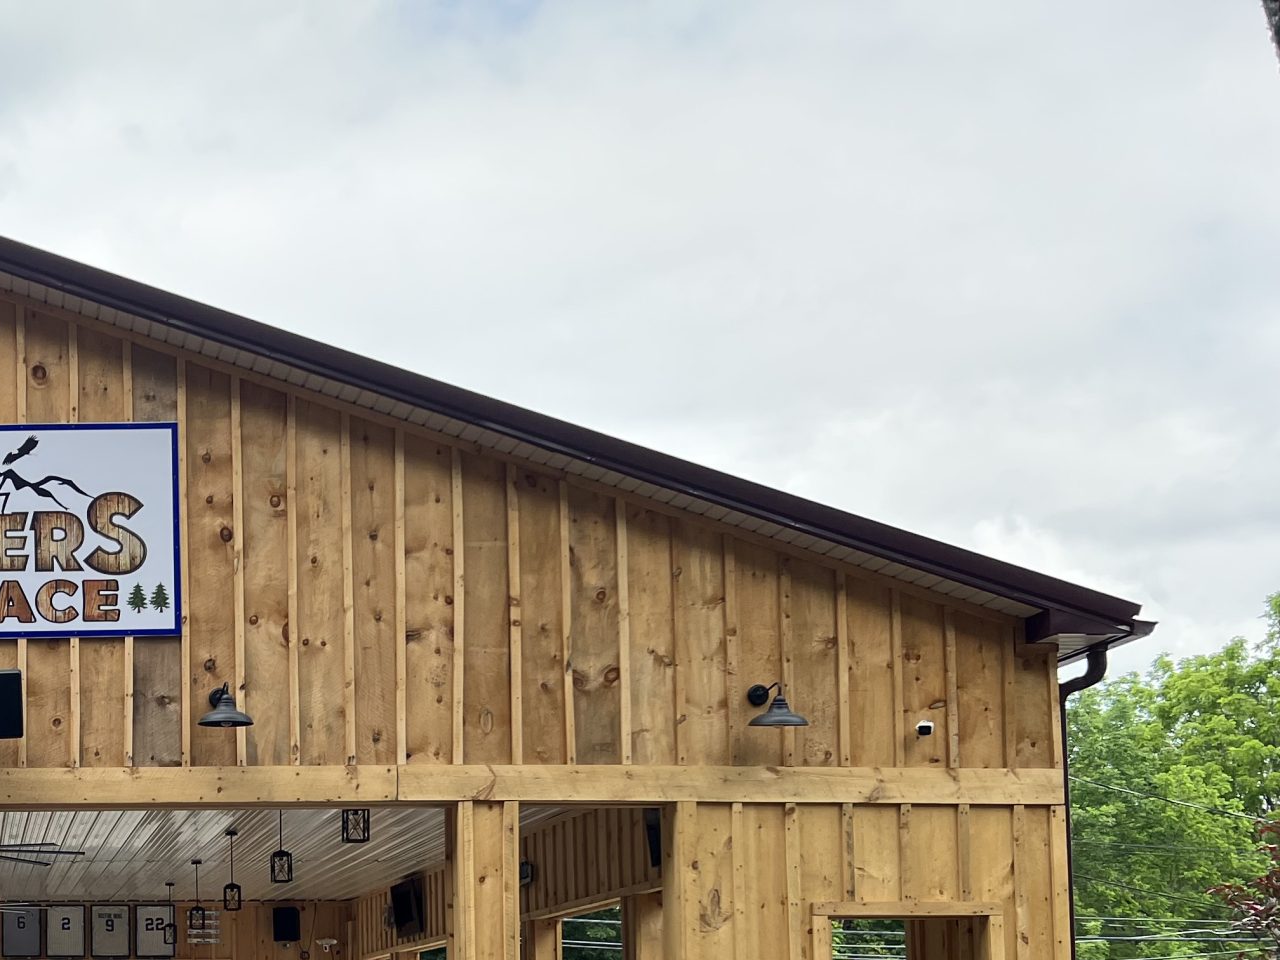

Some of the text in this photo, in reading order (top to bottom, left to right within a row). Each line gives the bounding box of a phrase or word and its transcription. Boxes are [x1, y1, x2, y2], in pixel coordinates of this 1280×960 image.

[17, 916, 25, 929] 6
[61, 917, 70, 930] 2
[105, 919, 114, 932] 9
[145, 918, 164, 931] 22
